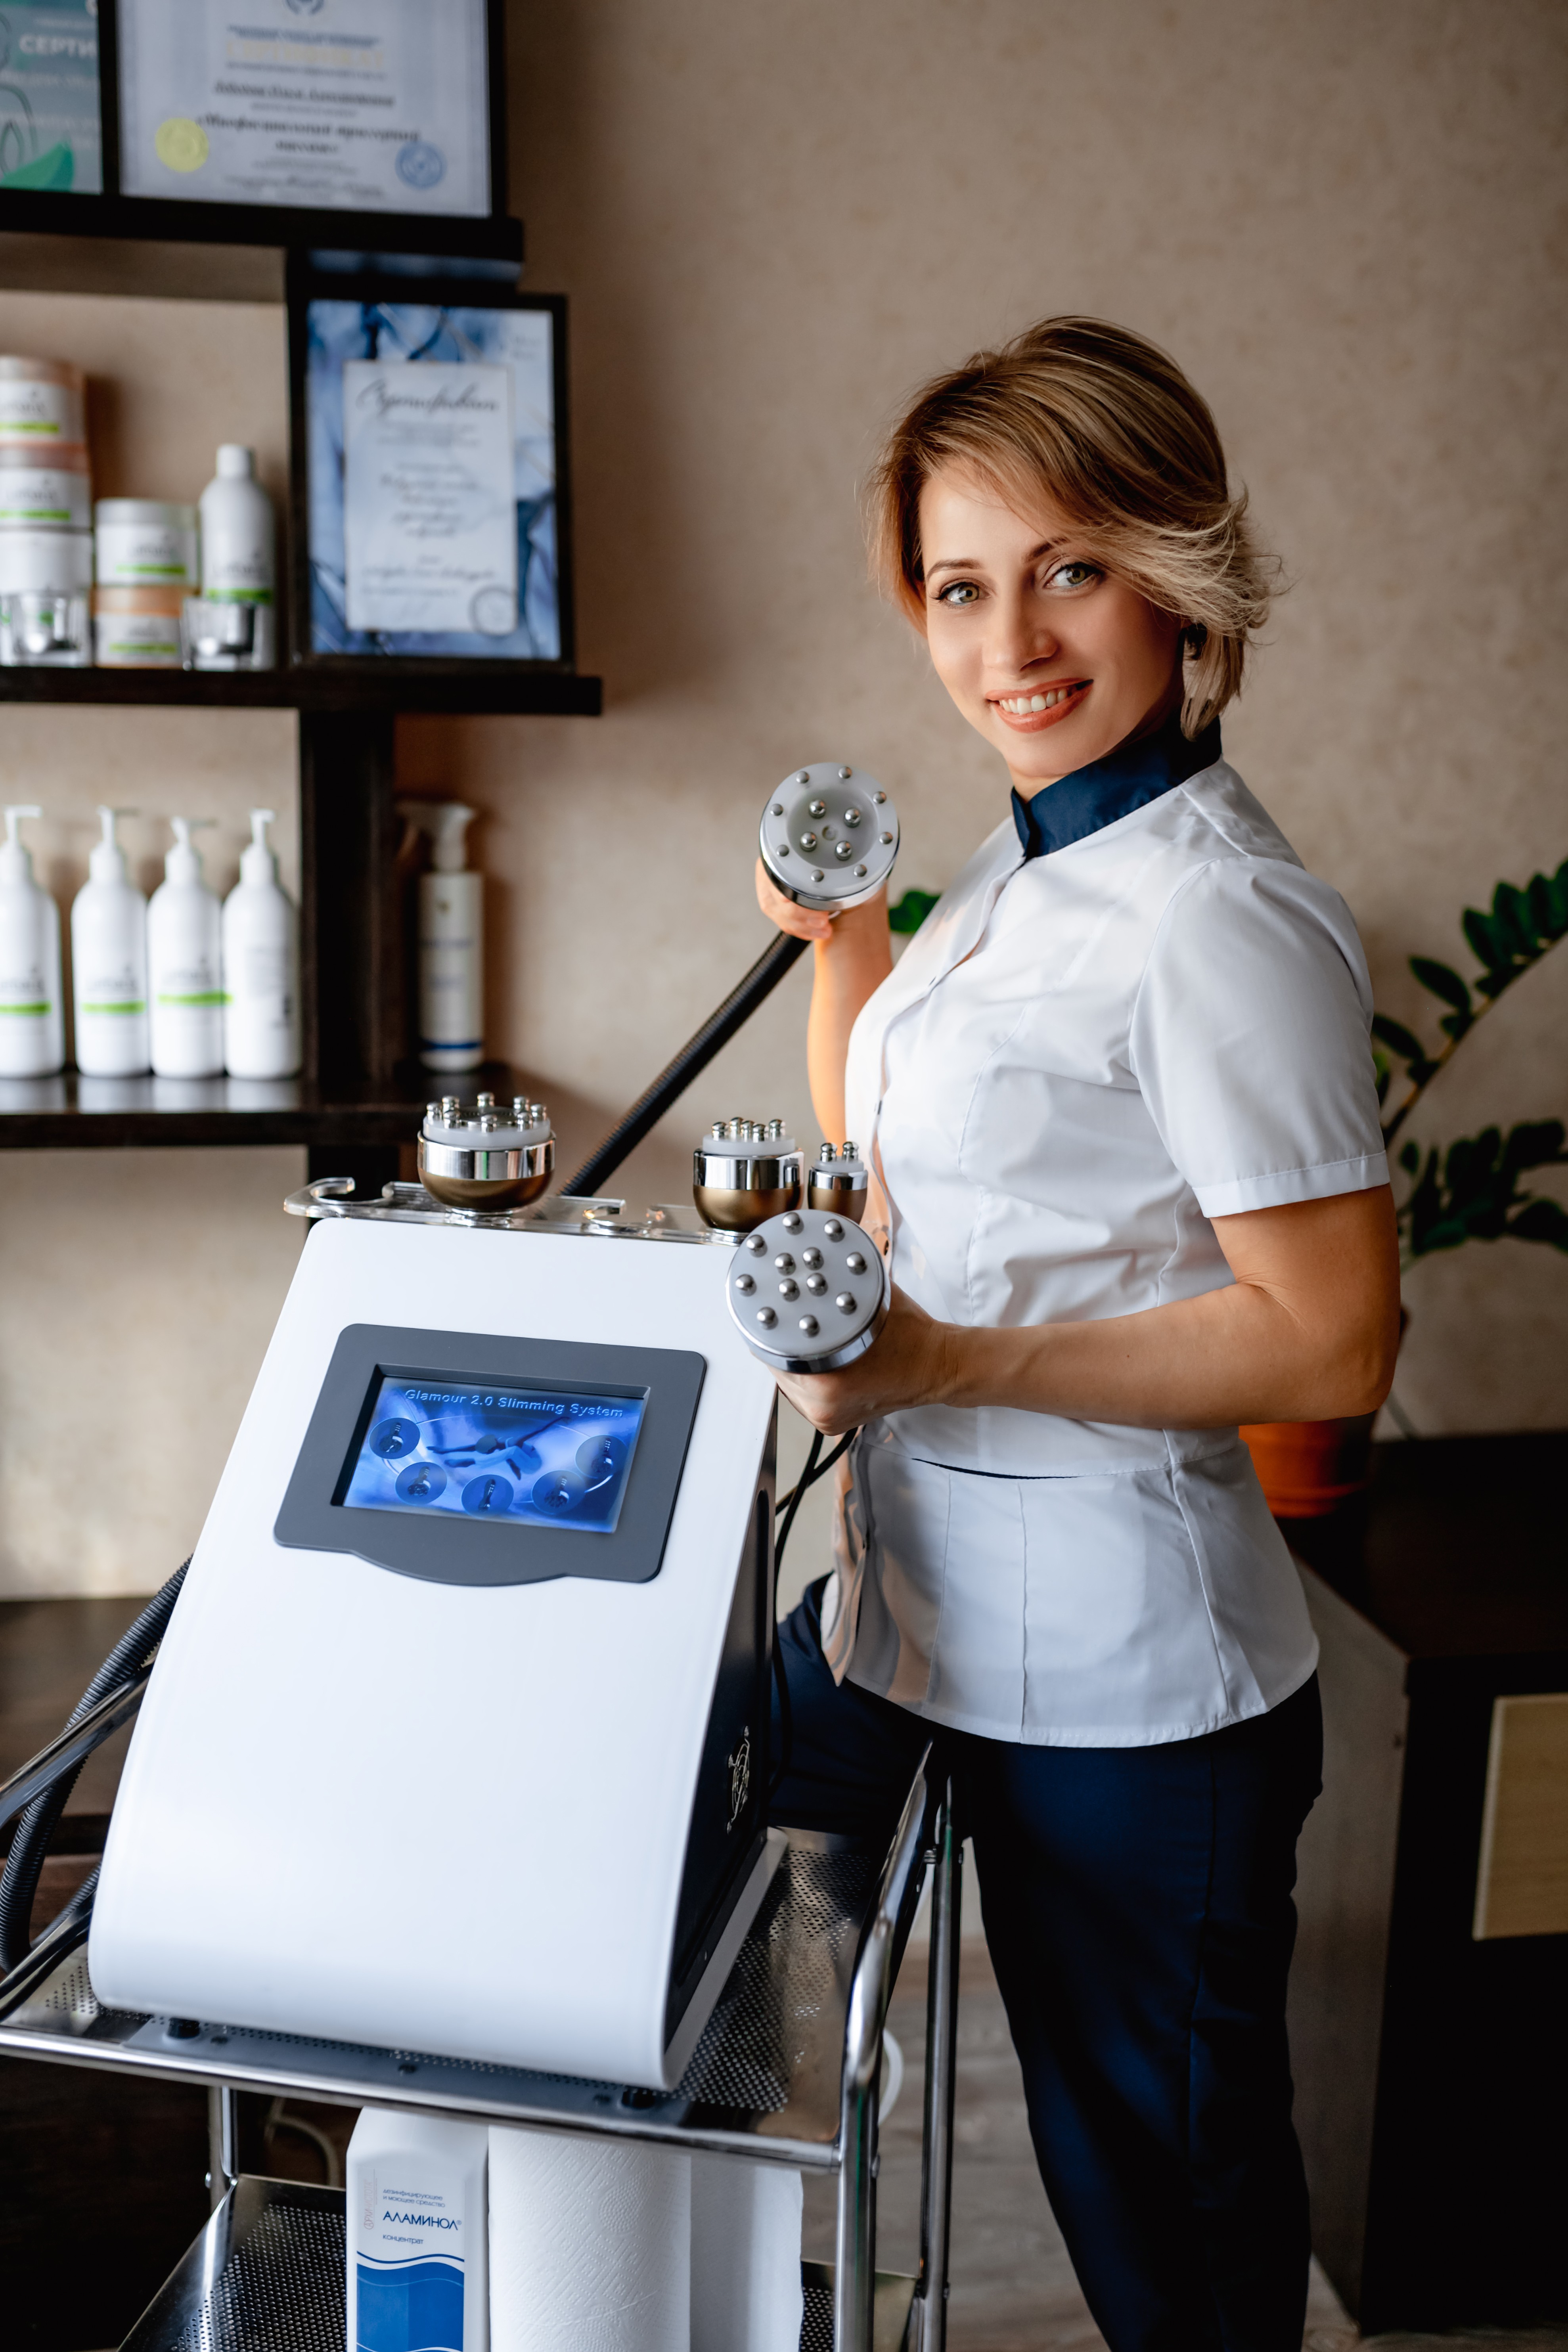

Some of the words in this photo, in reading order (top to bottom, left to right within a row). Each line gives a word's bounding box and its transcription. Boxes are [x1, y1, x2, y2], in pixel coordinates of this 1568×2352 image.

[405, 1389, 467, 1403] Glamour
[471, 1395, 493, 1406] 2.0
[498, 1397, 565, 1414] Slimming
[570, 1403, 623, 1417] System
[383, 2189, 443, 2201] дезинфицирующее
[383, 2234, 423, 2245] концентрат
